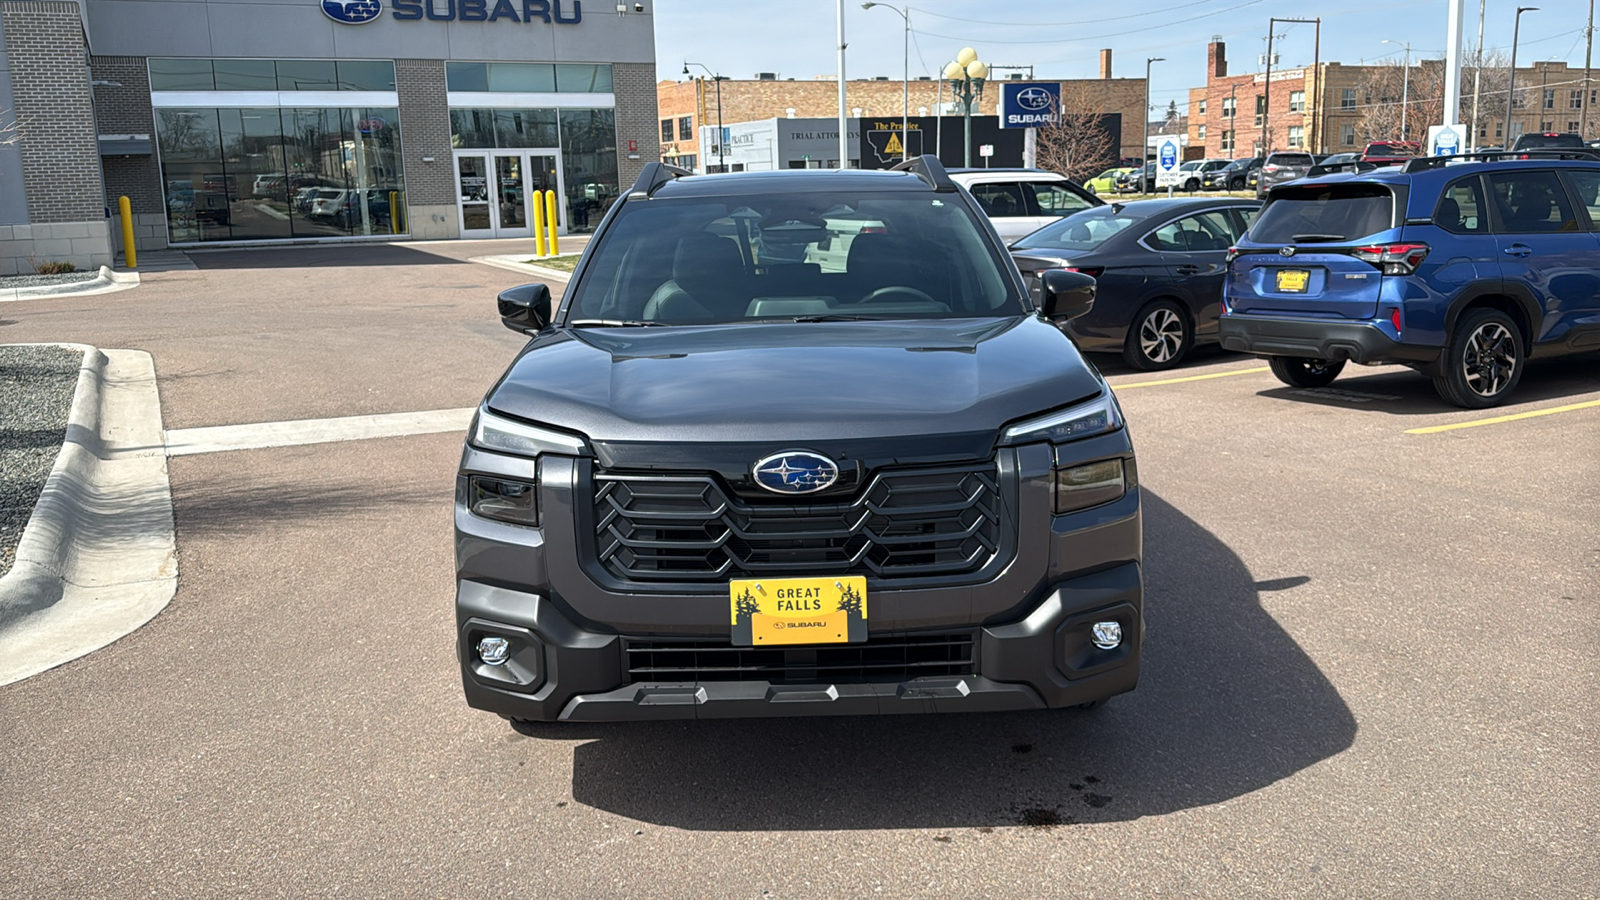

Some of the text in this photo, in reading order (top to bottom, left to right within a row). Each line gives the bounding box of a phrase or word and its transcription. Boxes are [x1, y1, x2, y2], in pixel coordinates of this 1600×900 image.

[392, 0, 581, 24] SUBARU
[358, 119, 383, 130] OPEN
[1008, 114, 1056, 124] SUBARU
[874, 122, 919, 130] The Pratice
[731, 133, 754, 144] PRACTICE
[790, 131, 860, 140] TRIAL ATTOREYS
[777, 588, 821, 599] GREAT
[777, 599, 821, 611] FALLS
